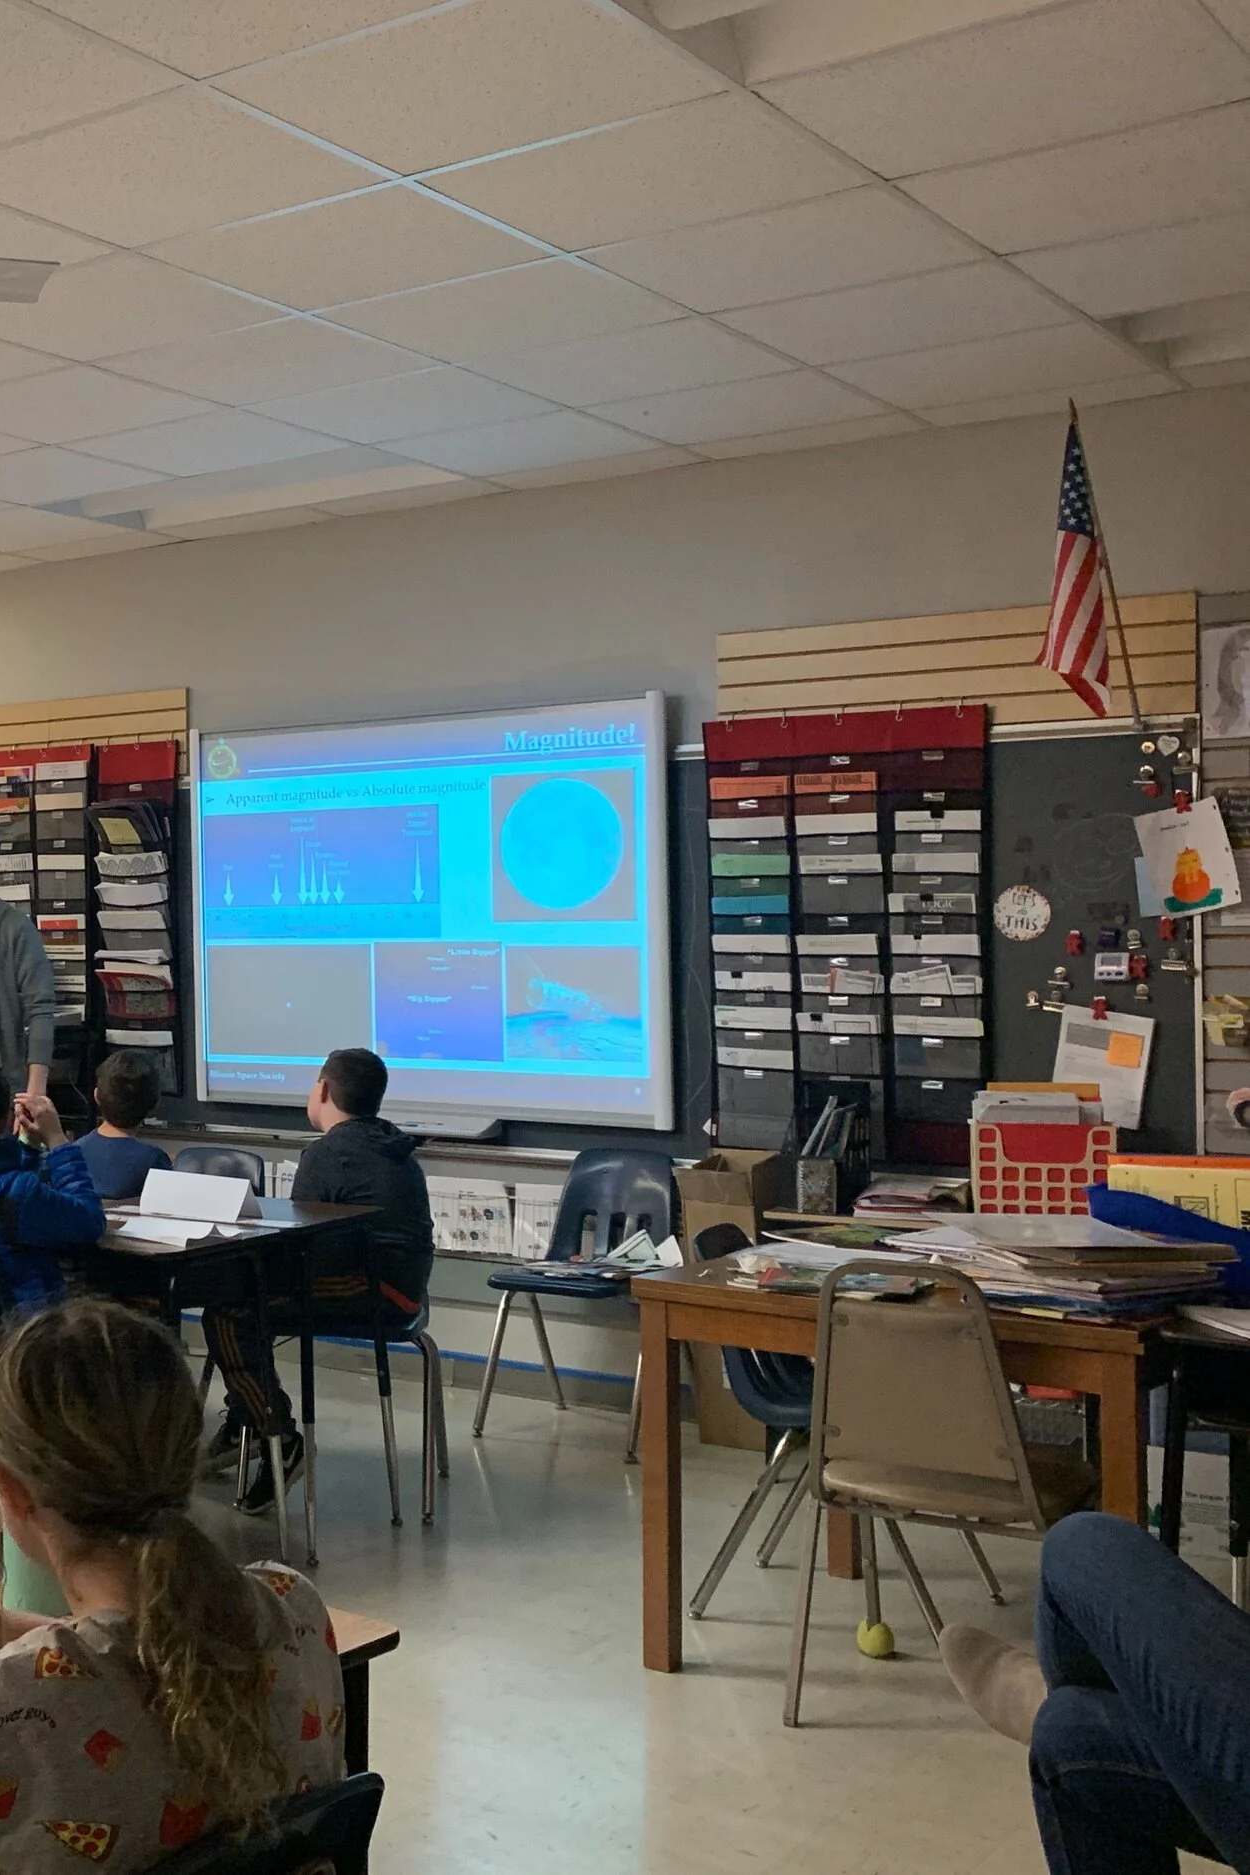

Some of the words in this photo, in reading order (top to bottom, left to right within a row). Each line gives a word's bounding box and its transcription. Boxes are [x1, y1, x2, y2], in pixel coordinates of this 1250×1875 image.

[503, 723, 636, 755] Magnitude!
[226, 793, 279, 807] Apparent
[281, 788, 342, 803] magnitude
[346, 788, 359, 798] vs
[362, 783, 414, 797] Absolute
[418, 778, 486, 795] magnitude
[1005, 915, 1038, 931] THIS
[235, 1071, 258, 1081] Space
[24, 1706, 57, 1729] guys
